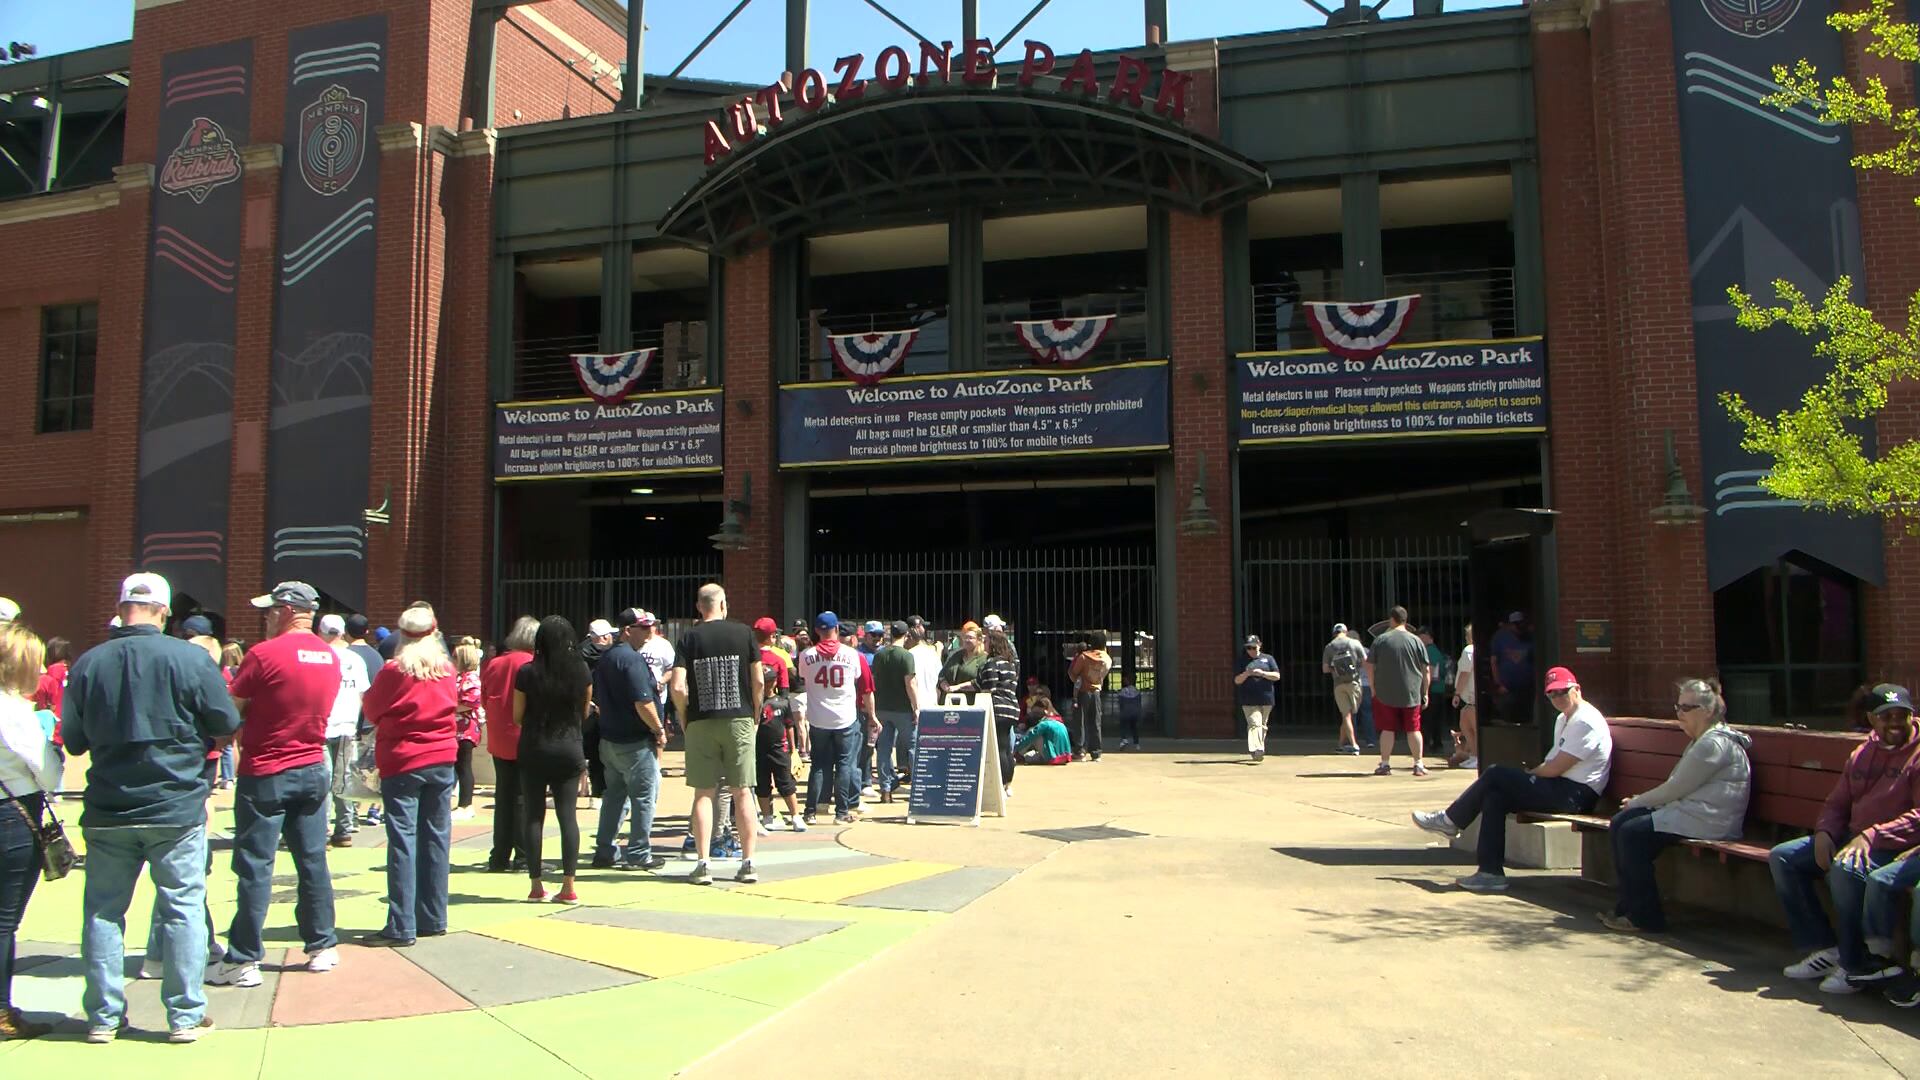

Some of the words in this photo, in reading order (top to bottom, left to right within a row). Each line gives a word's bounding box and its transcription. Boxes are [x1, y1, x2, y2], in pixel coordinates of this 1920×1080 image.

[1744, 19, 1766, 31] FC
[703, 37, 997, 165] AUTOZONE
[1018, 38, 1192, 126] PARK
[323, 181, 337, 190] FC
[1247, 360, 1339, 378] Welcome
[1344, 358, 1365, 372] to
[1371, 351, 1474, 370] AutoZone
[1481, 347, 1533, 366] Park
[847, 388, 926, 404] Welcome
[930, 385, 948, 399] to
[953, 379, 1043, 399] AutoZone
[1048, 375, 1093, 392] Park
[1242, 391, 1264, 402] Metal
[1266, 390, 1303, 401] detectors
[1305, 389, 1313, 399] in
[1315, 389, 1328, 399] use
[1335, 386, 1362, 398] Please
[1364, 385, 1388, 398] empty
[1390, 384, 1422, 397] pockets
[1428, 382, 1466, 394] Weapons
[1467, 379, 1497, 392] strictly
[1499, 377, 1541, 391] prohibited
[504, 410, 570, 424] Welcome
[575, 408, 590, 421] to
[594, 402, 671, 420] AutoZone
[676, 399, 715, 415] Park
[804, 417, 828, 427] Metal
[830, 415, 872, 426] detectors
[874, 414, 882, 424] in
[884, 414, 901, 424] use
[908, 411, 938, 422] Please
[940, 409, 968, 423] empty
[970, 406, 1006, 419] pockets
[1014, 405, 1056, 417] Weapons
[1058, 402, 1092, 415] strictly
[1094, 398, 1143, 413] prohibited
[1348, 403, 1369, 415] bags
[1370, 401, 1403, 412] allowed
[1405, 400, 1421, 411] this
[1466, 397, 1497, 409] subject
[1499, 397, 1508, 406] to
[1510, 395, 1541, 406] search
[856, 429, 867, 440] All
[869, 428, 890, 441] bags
[892, 427, 914, 438] must
[916, 426, 928, 437] be
[929, 425, 958, 437] CLEAR
[960, 425, 970, 434] or
[973, 421, 1006, 434] smaller
[1009, 422, 1030, 432] than
[1252, 423, 1296, 435] Increase
[1300, 420, 1330, 434] phone
[1334, 417, 1388, 432] brightness
[1391, 417, 1402, 428] to
[1405, 414, 1435, 428] 100%
[1438, 414, 1454, 426] for
[1457, 412, 1493, 425] mobile
[1496, 411, 1533, 424] tickets
[510, 449, 520, 459] All
[850, 445, 888, 456] Increase
[890, 443, 918, 456] phone
[920, 441, 967, 453] brightness
[969, 440, 979, 450] to
[982, 437, 1008, 449] 100%
[1010, 436, 1024, 447] for
[1026, 435, 1057, 447] mobile
[1060, 434, 1093, 446] tickets
[607, 458, 616, 469] to
[814, 664, 844, 689] 40
